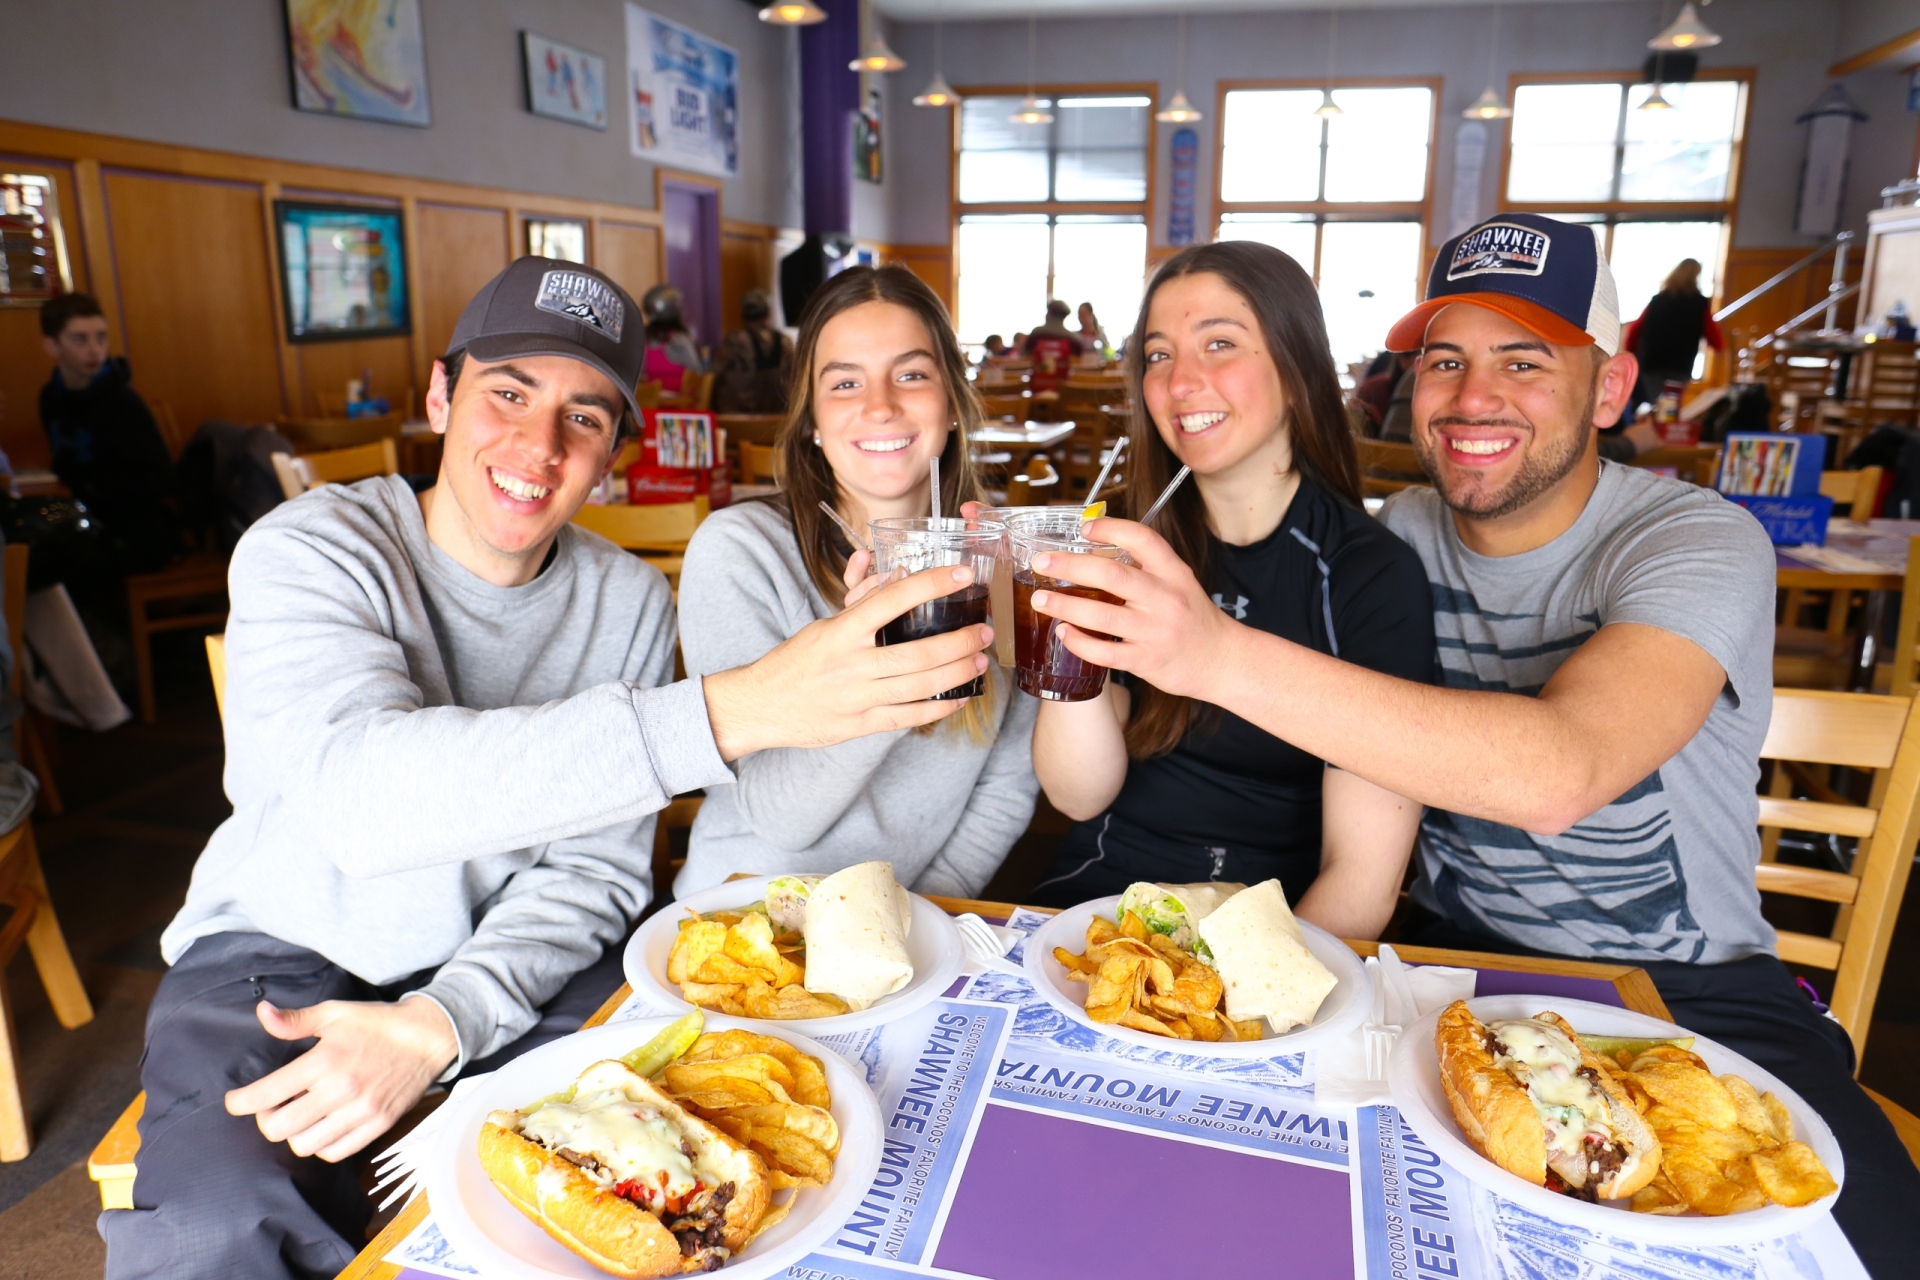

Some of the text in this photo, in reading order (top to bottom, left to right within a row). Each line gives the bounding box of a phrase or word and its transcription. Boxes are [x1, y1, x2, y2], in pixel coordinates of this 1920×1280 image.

[1457, 243, 1541, 260] MOUNTAIN
[1459, 227, 1544, 254] SHAWNEE
[549, 273, 622, 317] SHAWNEE
[961, 1015, 989, 1060] WELCOME
[889, 1012, 969, 1135] SHAWNEE
[956, 1060, 970, 1073] TO
[947, 1073, 967, 1094] THE
[1018, 1084, 1078, 1102] FAMILY
[1083, 1095, 1166, 1118] FAVORITE
[1268, 1131, 1303, 1146] THE
[1377, 1110, 1396, 1150] FAMILY
[1309, 1139, 1333, 1151] TO
[903, 1149, 937, 1207] FAVORITE
[1380, 1151, 1401, 1209] FAVORITE
[884, 1207, 914, 1259] FAMILY
[1519, 1235, 1580, 1262] Upper Arrowhead
